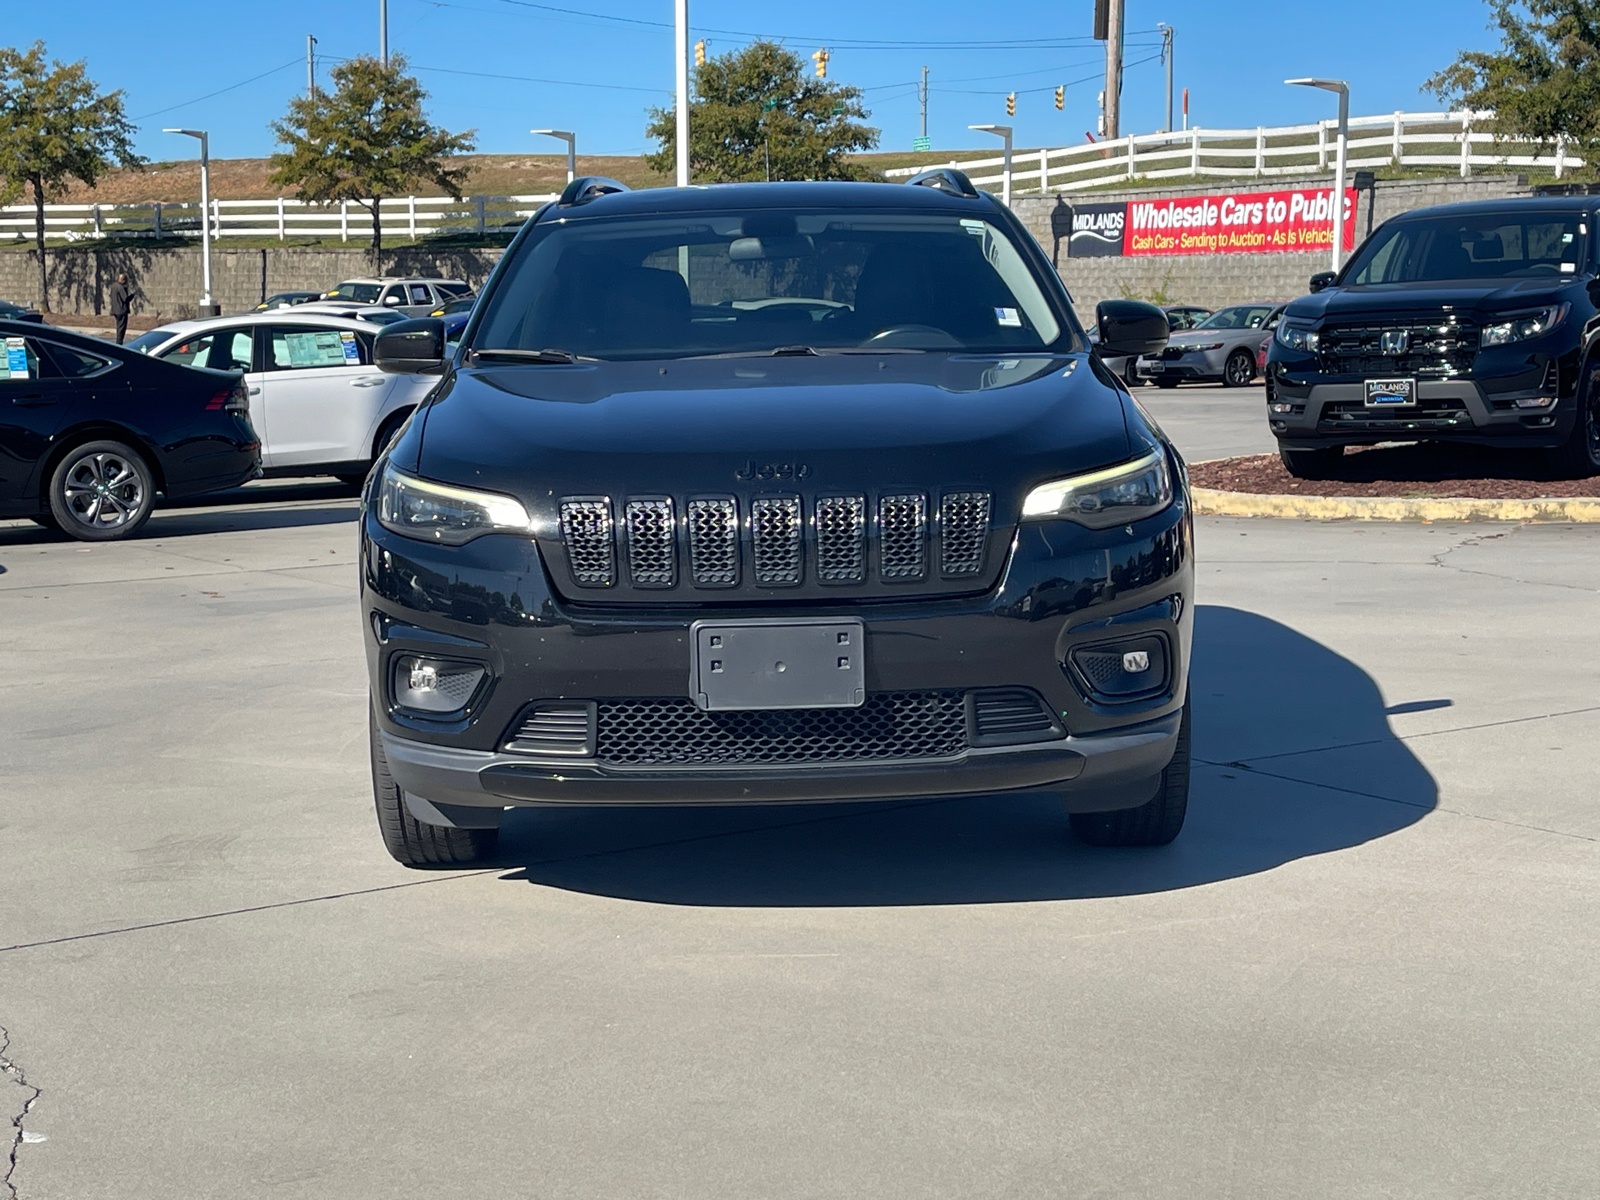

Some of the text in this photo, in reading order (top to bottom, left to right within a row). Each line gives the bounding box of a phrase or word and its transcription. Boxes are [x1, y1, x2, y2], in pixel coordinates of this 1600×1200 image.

[1073, 212, 1124, 231] MIDLANDS
[1132, 191, 1351, 230] Wholesale Cars to Publc
[1132, 227, 1335, 251] Cash Cars Sending to Auction As Is Vehicle
[1369, 383, 1410, 391] MIDLANDS
[734, 459, 813, 482] Jeep
